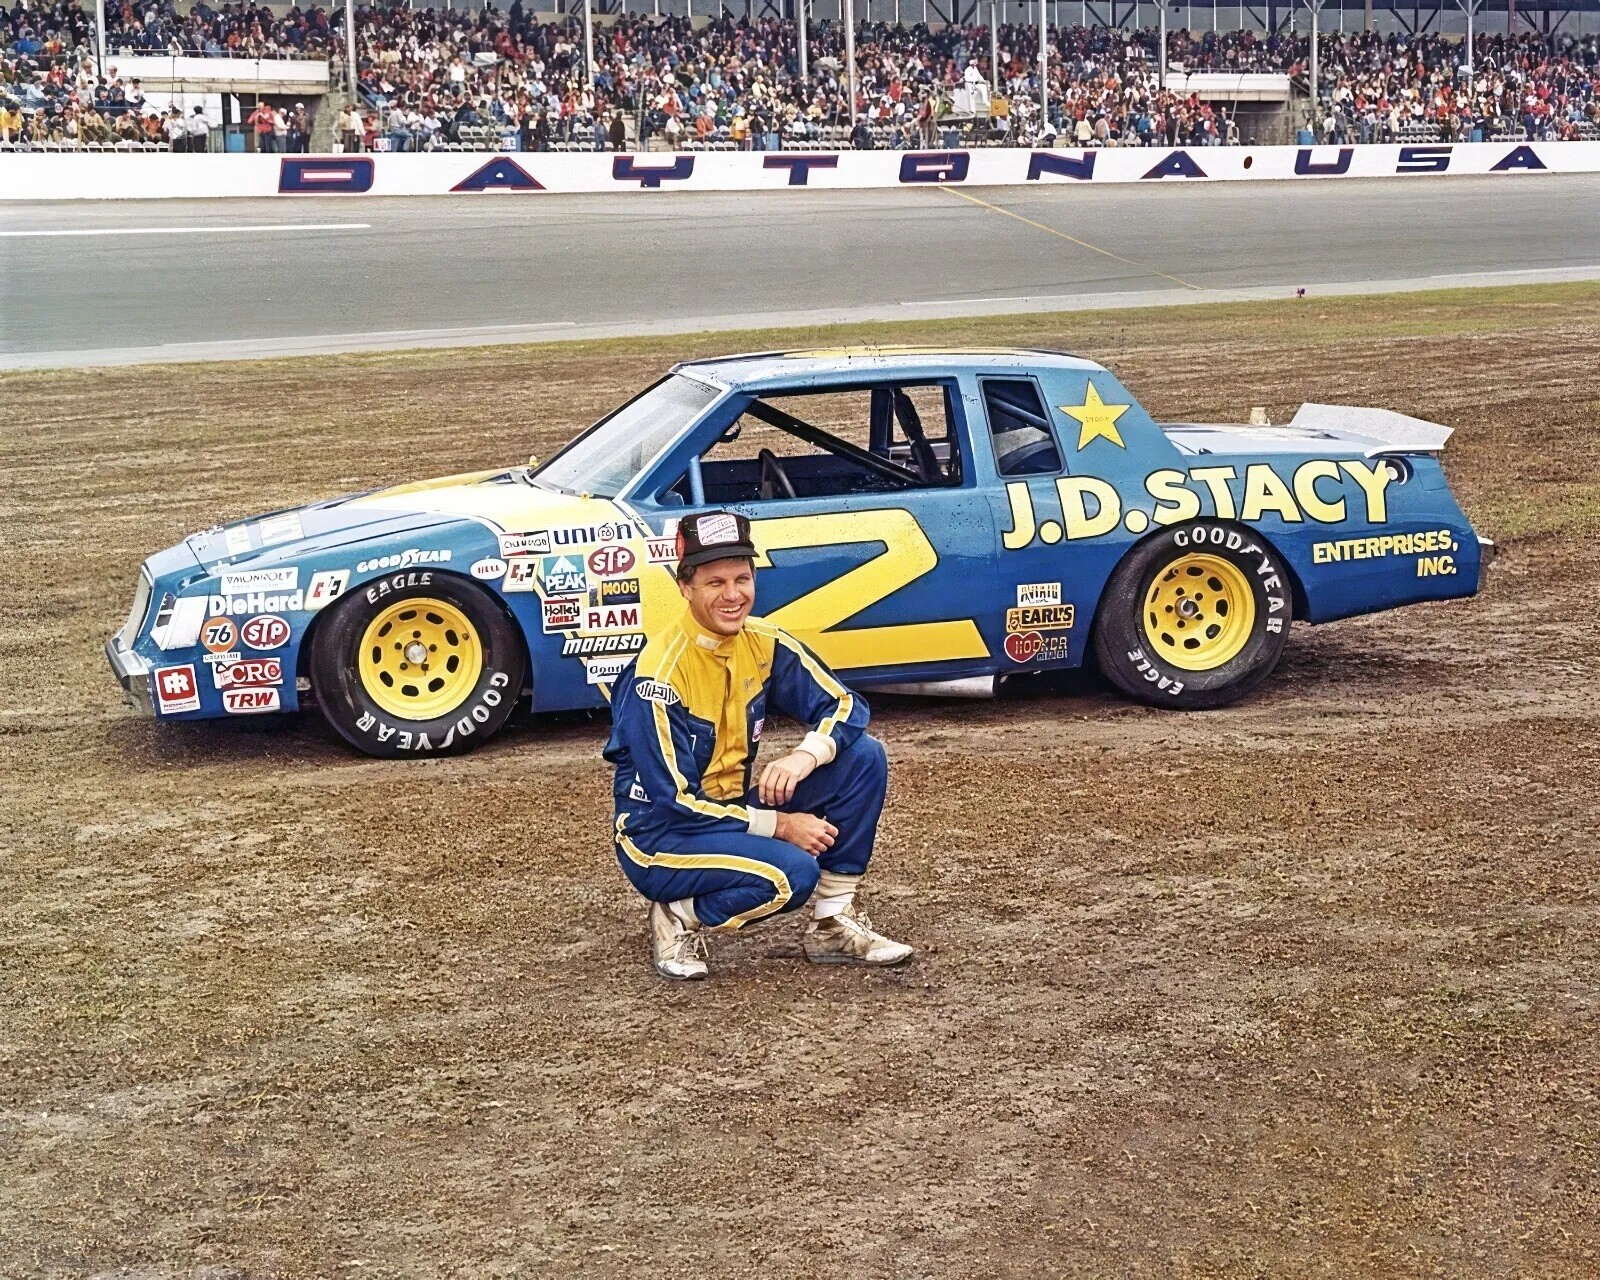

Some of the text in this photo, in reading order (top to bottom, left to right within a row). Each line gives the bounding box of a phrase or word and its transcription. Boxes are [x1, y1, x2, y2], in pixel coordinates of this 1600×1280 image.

[278, 145, 1547, 193] DAYTONA USA
[593, 547, 630, 571] STP
[1313, 530, 1458, 564] ENTERPRISES,
[357, 549, 452, 573] GOODYEAR
[1417, 556, 1456, 577] INC.
[366, 573, 433, 605] EAGLE
[545, 573, 586, 591] PEAK
[750, 508, 990, 670] 2
[1174, 527, 1285, 634] GOODYEAR
[209, 589, 304, 617] DieHard
[545, 603, 580, 617] Holley
[588, 609, 638, 629] RAM
[1021, 607, 1073, 625] EARL'S
[206, 623, 232, 645] 76
[247, 619, 284, 643] STP
[562, 635, 643, 655] MOROSO
[1127, 649, 1185, 696] EAGLE
[226, 692, 274, 708] TRW
[355, 671, 509, 750] GOODYEAR
